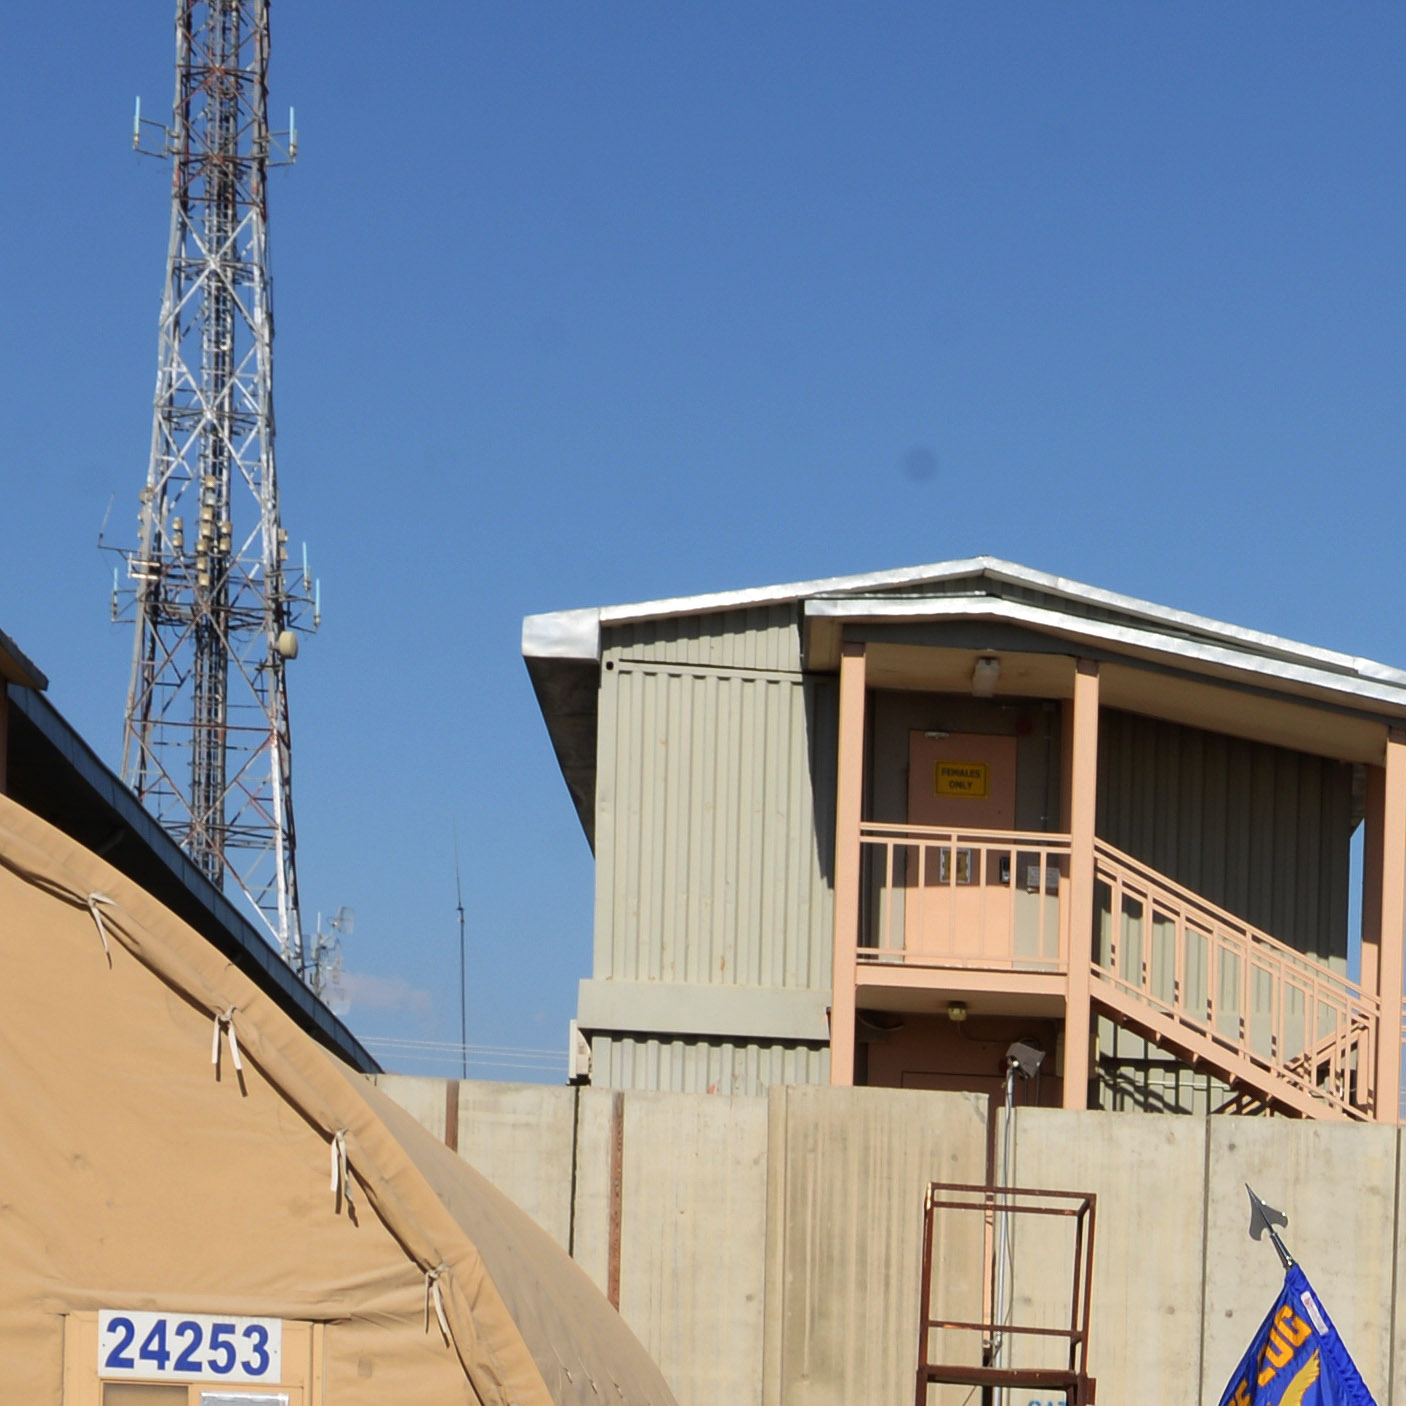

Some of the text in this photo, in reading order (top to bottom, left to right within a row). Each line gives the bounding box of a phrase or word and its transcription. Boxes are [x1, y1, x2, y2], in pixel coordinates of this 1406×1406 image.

[941, 767, 980, 779] FEMALES
[949, 779, 973, 790] ONLY
[105, 1317, 271, 1377] 24253
